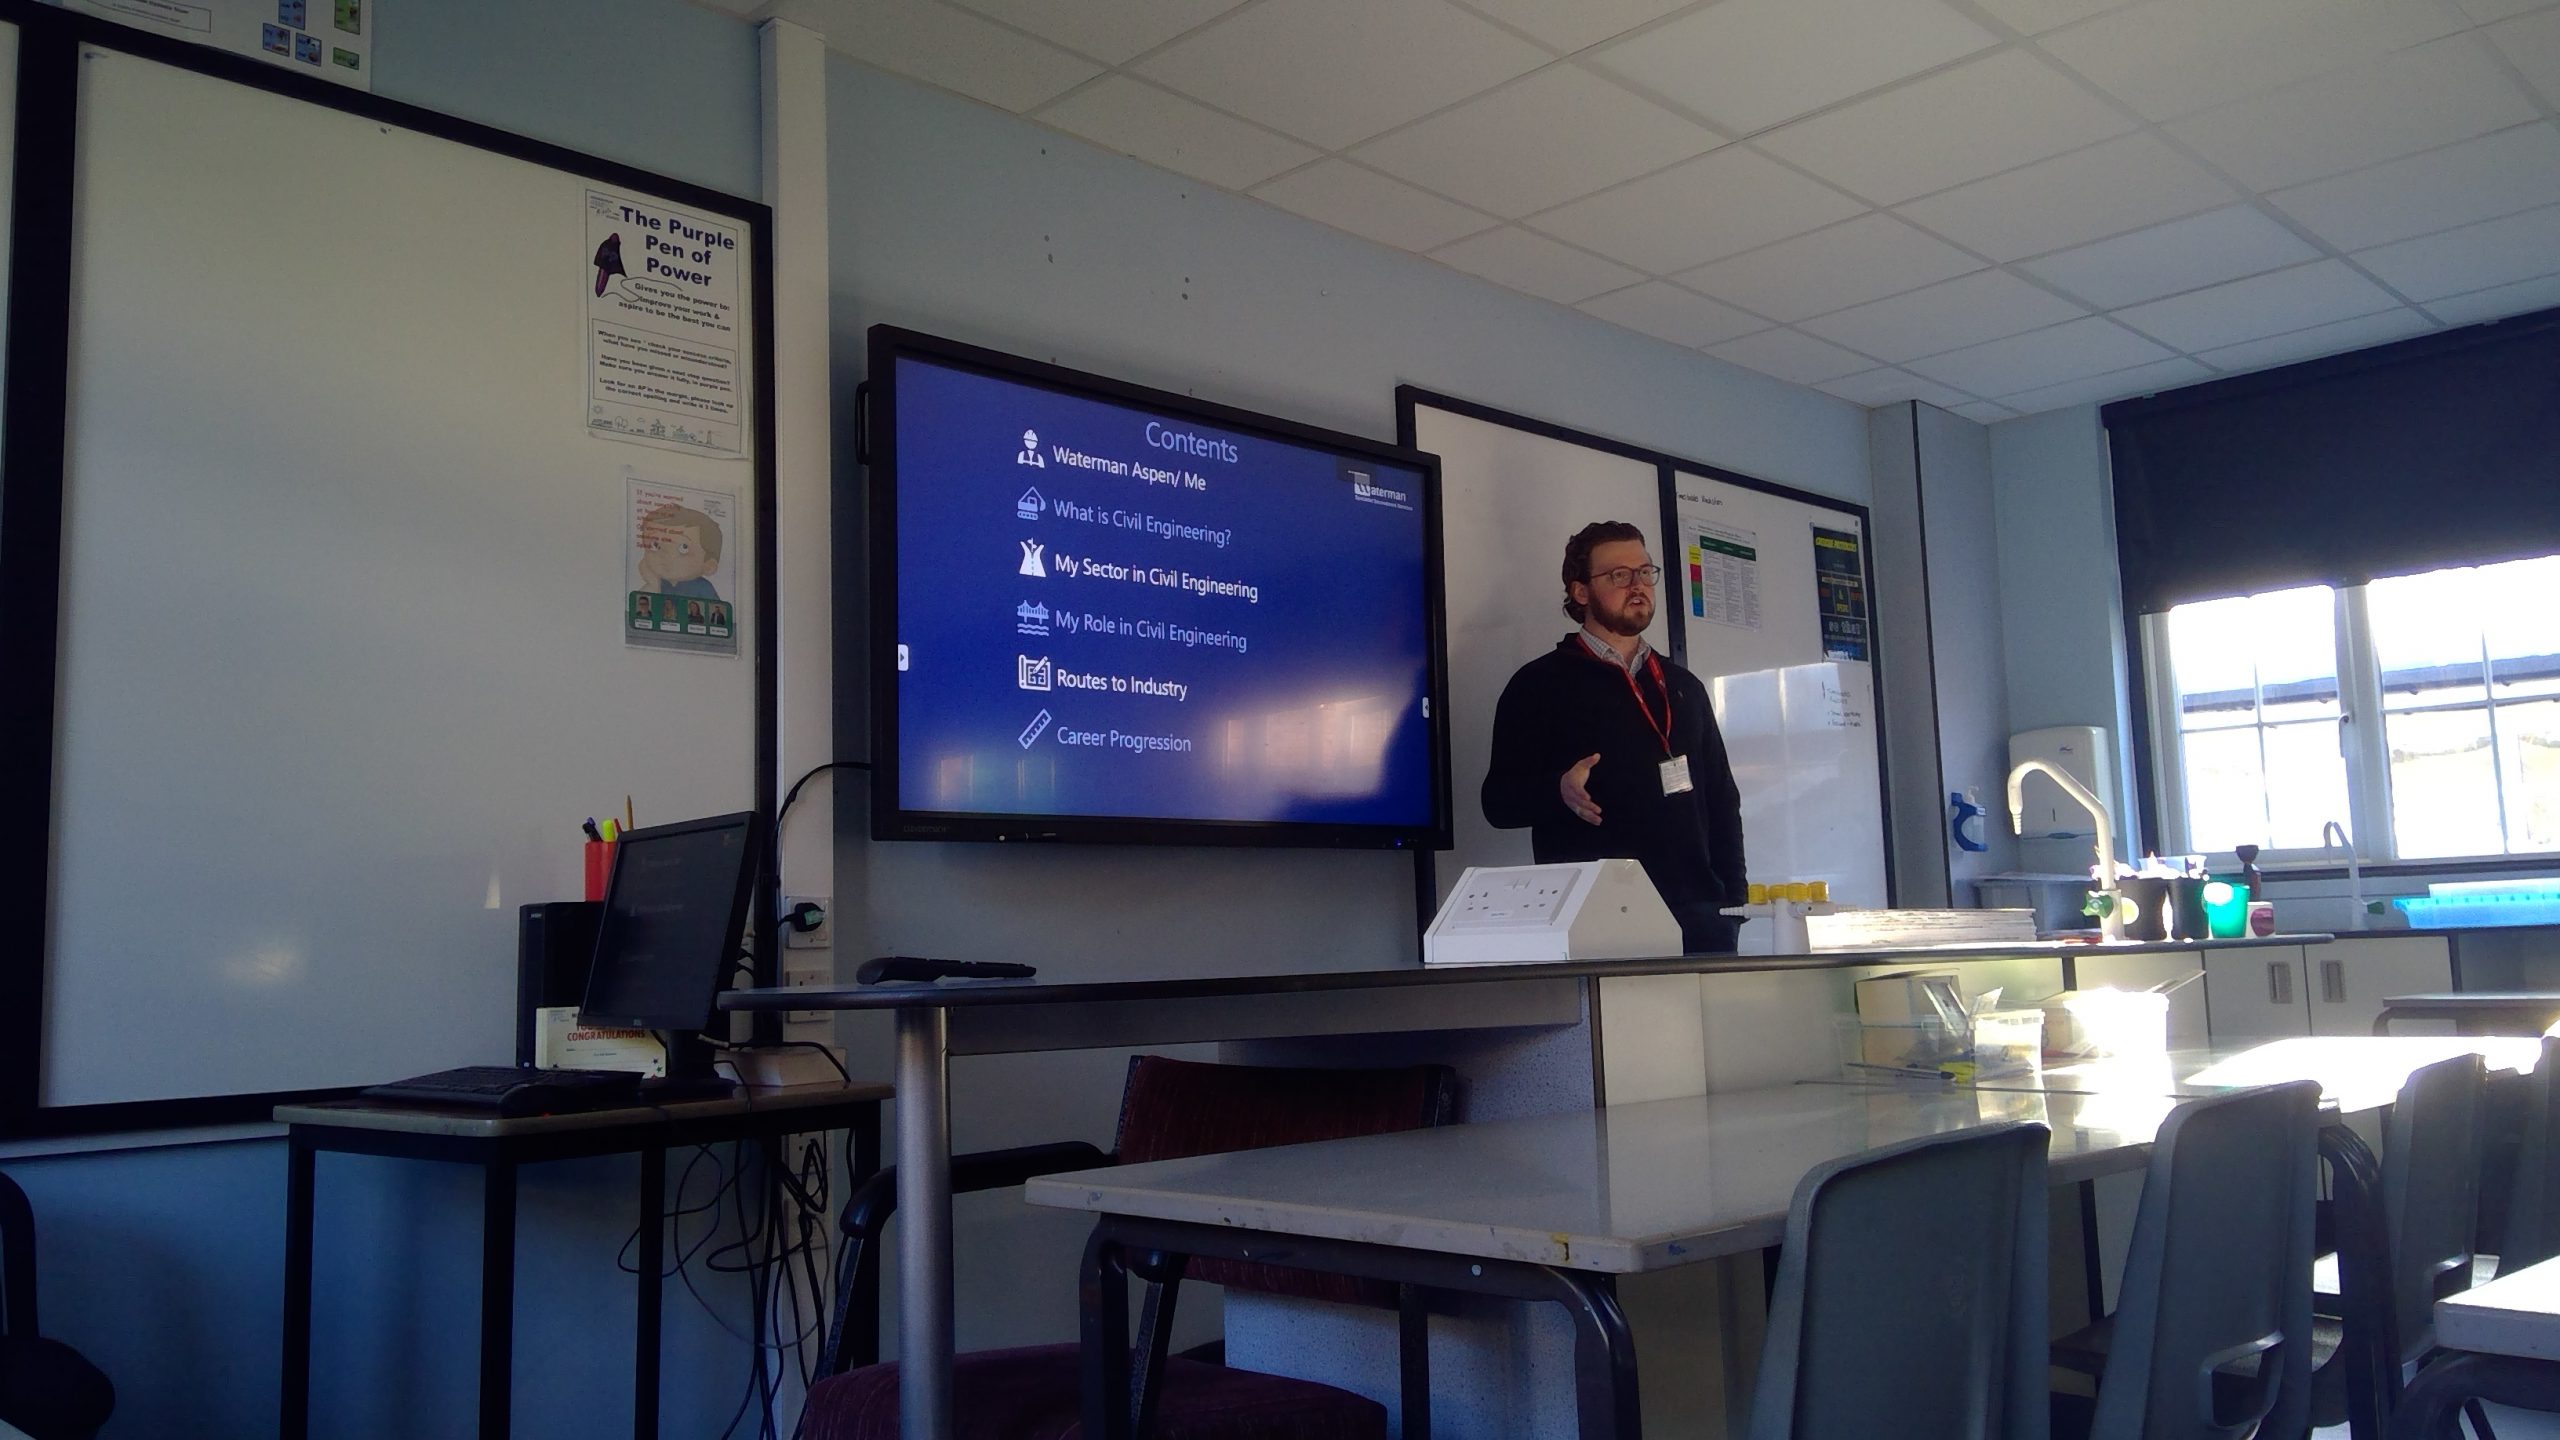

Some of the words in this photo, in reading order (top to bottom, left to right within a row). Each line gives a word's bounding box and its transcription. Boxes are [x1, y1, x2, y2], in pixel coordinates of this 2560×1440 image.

[620, 205, 661, 230] The
[669, 218, 735, 250] Purple
[645, 234, 684, 259] Pen
[691, 250, 712, 265] of
[646, 257, 712, 287] Power
[634, 282, 658, 294] Gives
[660, 290, 675, 298] you
[677, 293, 691, 302] the
[692, 298, 718, 308] power
[720, 303, 730, 311] to:
[674, 305, 691, 313] your
[692, 309, 712, 318] work
[618, 301, 643, 312] aspire
[668, 312, 681, 320] the
[682, 315, 700, 325] best
[702, 320, 715, 329] you
[716, 324, 731, 332] can
[1145, 421, 1239, 464] Contents
[1052, 445, 1128, 477] Waterman
[1132, 464, 1181, 488] Aspen/
[1185, 472, 1207, 491] Me
[1054, 499, 1094, 524] What
[1097, 506, 1109, 525] is
[1113, 510, 1142, 531] Civil
[1146, 516, 1232, 549] Engineering?
[1055, 553, 1078, 578] My
[1083, 558, 1128, 581] Sector
[1132, 564, 1146, 583] in
[1149, 568, 1178, 589] Civil
[1182, 573, 1258, 603] Engineering
[1055, 609, 1079, 634] My
[1083, 614, 1115, 634] Role
[1119, 617, 1132, 636] in
[1136, 620, 1165, 640] Civil
[1169, 624, 1247, 653] Engineering
[1057, 668, 1107, 690] Routes
[1111, 676, 1127, 692] to
[1131, 676, 1187, 701] Industry
[1057, 727, 1106, 746] Career
[1110, 730, 1191, 754] Progression
[567, 1029, 646, 1042] CONGRATULATIONS
